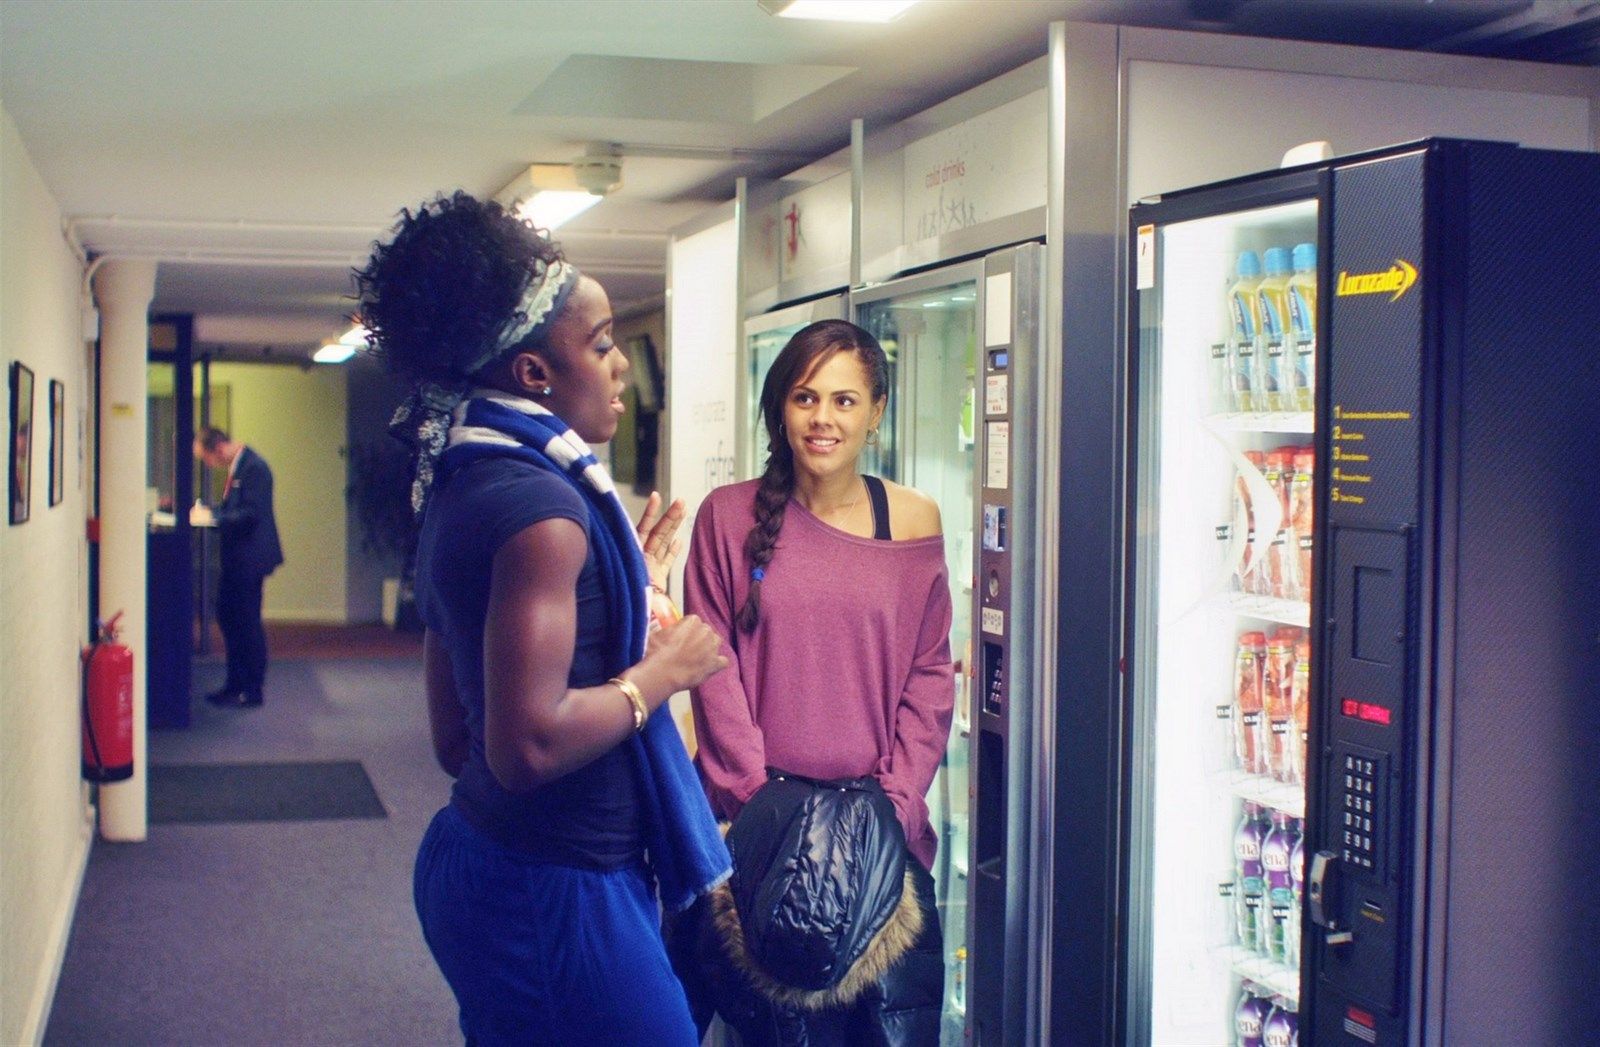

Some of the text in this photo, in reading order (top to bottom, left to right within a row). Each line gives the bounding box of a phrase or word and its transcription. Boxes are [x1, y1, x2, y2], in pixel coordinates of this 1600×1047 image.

[1336, 264, 1406, 297] Lucozade
[1333, 405, 1340, 419] 1
[1332, 426, 1340, 440] 2
[1332, 446, 1340, 460] 3
[1332, 467, 1340, 480] 4
[1331, 487, 1340, 501] 5
